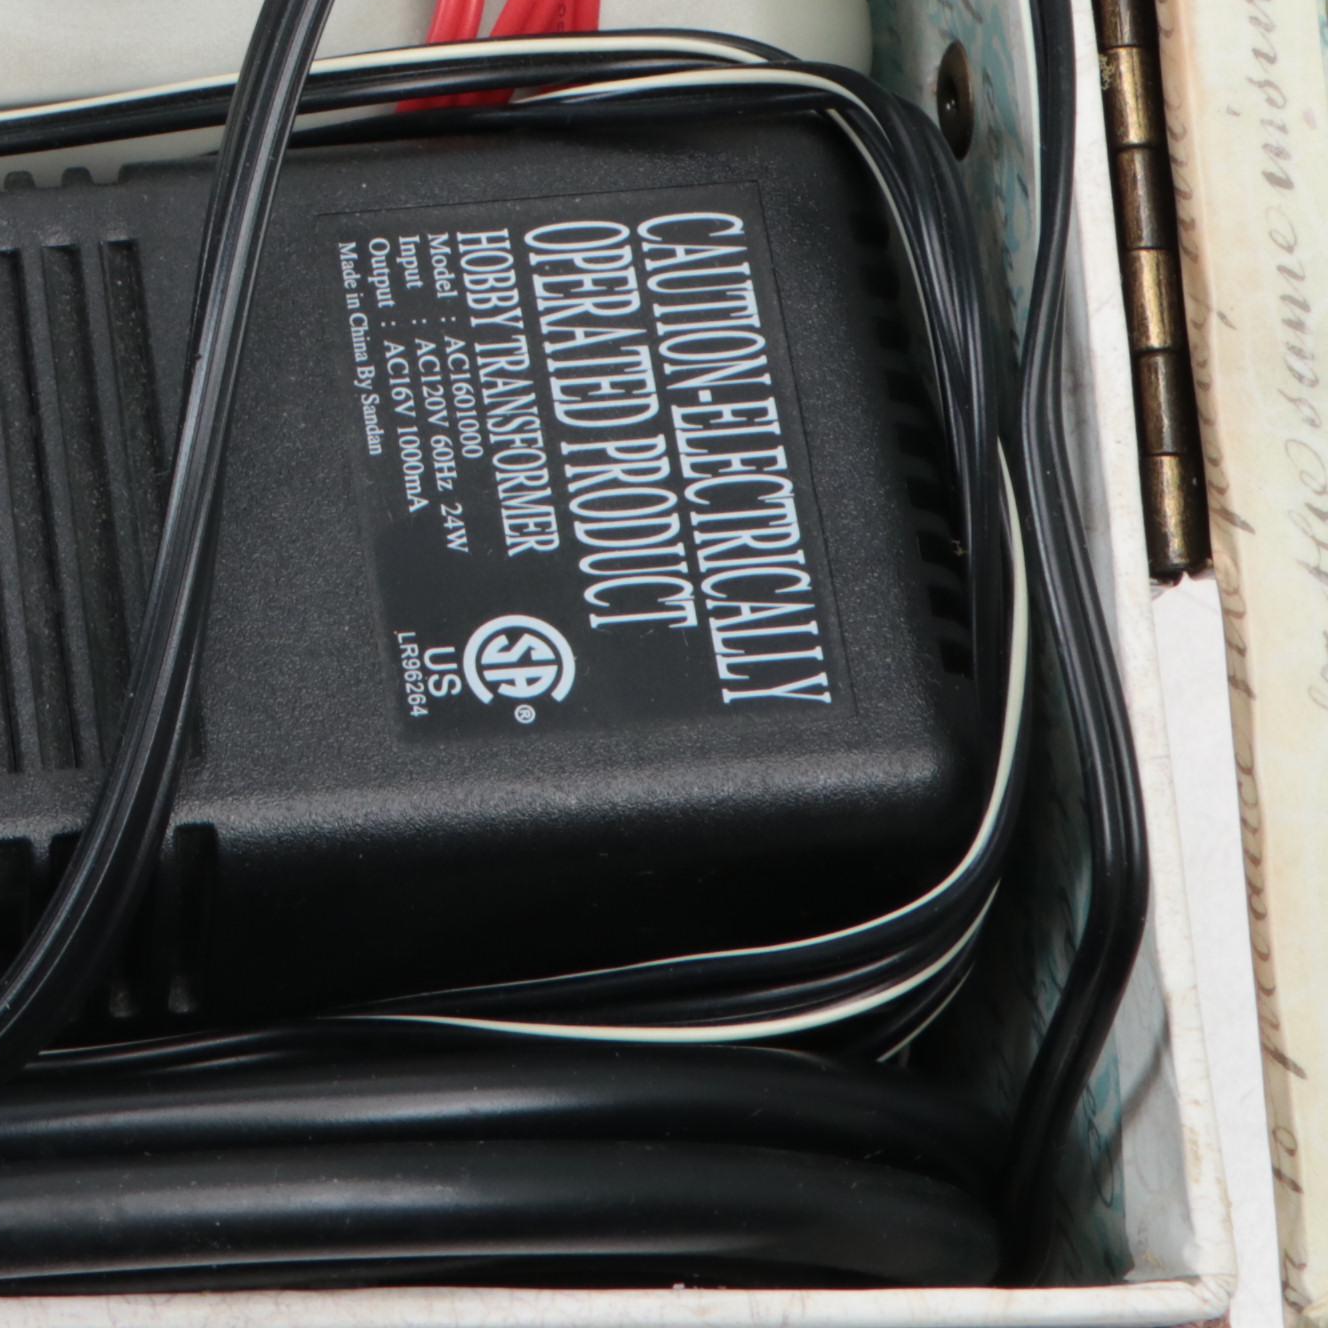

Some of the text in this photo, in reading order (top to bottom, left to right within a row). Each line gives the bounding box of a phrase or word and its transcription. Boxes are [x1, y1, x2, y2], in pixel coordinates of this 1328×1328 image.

[368, 237, 396, 310] Output
[398, 235, 423, 290] Input
[338, 241, 385, 456] Made in China By Sandan
[383, 339, 417, 419] AC16V
[415, 338, 450, 429] AC120V
[427, 232, 459, 299] Model
[444, 336, 484, 460] AC1601000
[455, 228, 561, 557] HOBBY TRANSFORMER
[524, 220, 698, 629] OPERATED PRODUCT
[397, 424, 430, 514] 1000mA
[429, 434, 458, 492] 60Hz
[636, 212, 832, 704] CAUTION-ELECTRICALLY
[440, 502, 470, 555] 24W
[397, 631, 430, 718] LR96264
[423, 646, 463, 698] US
